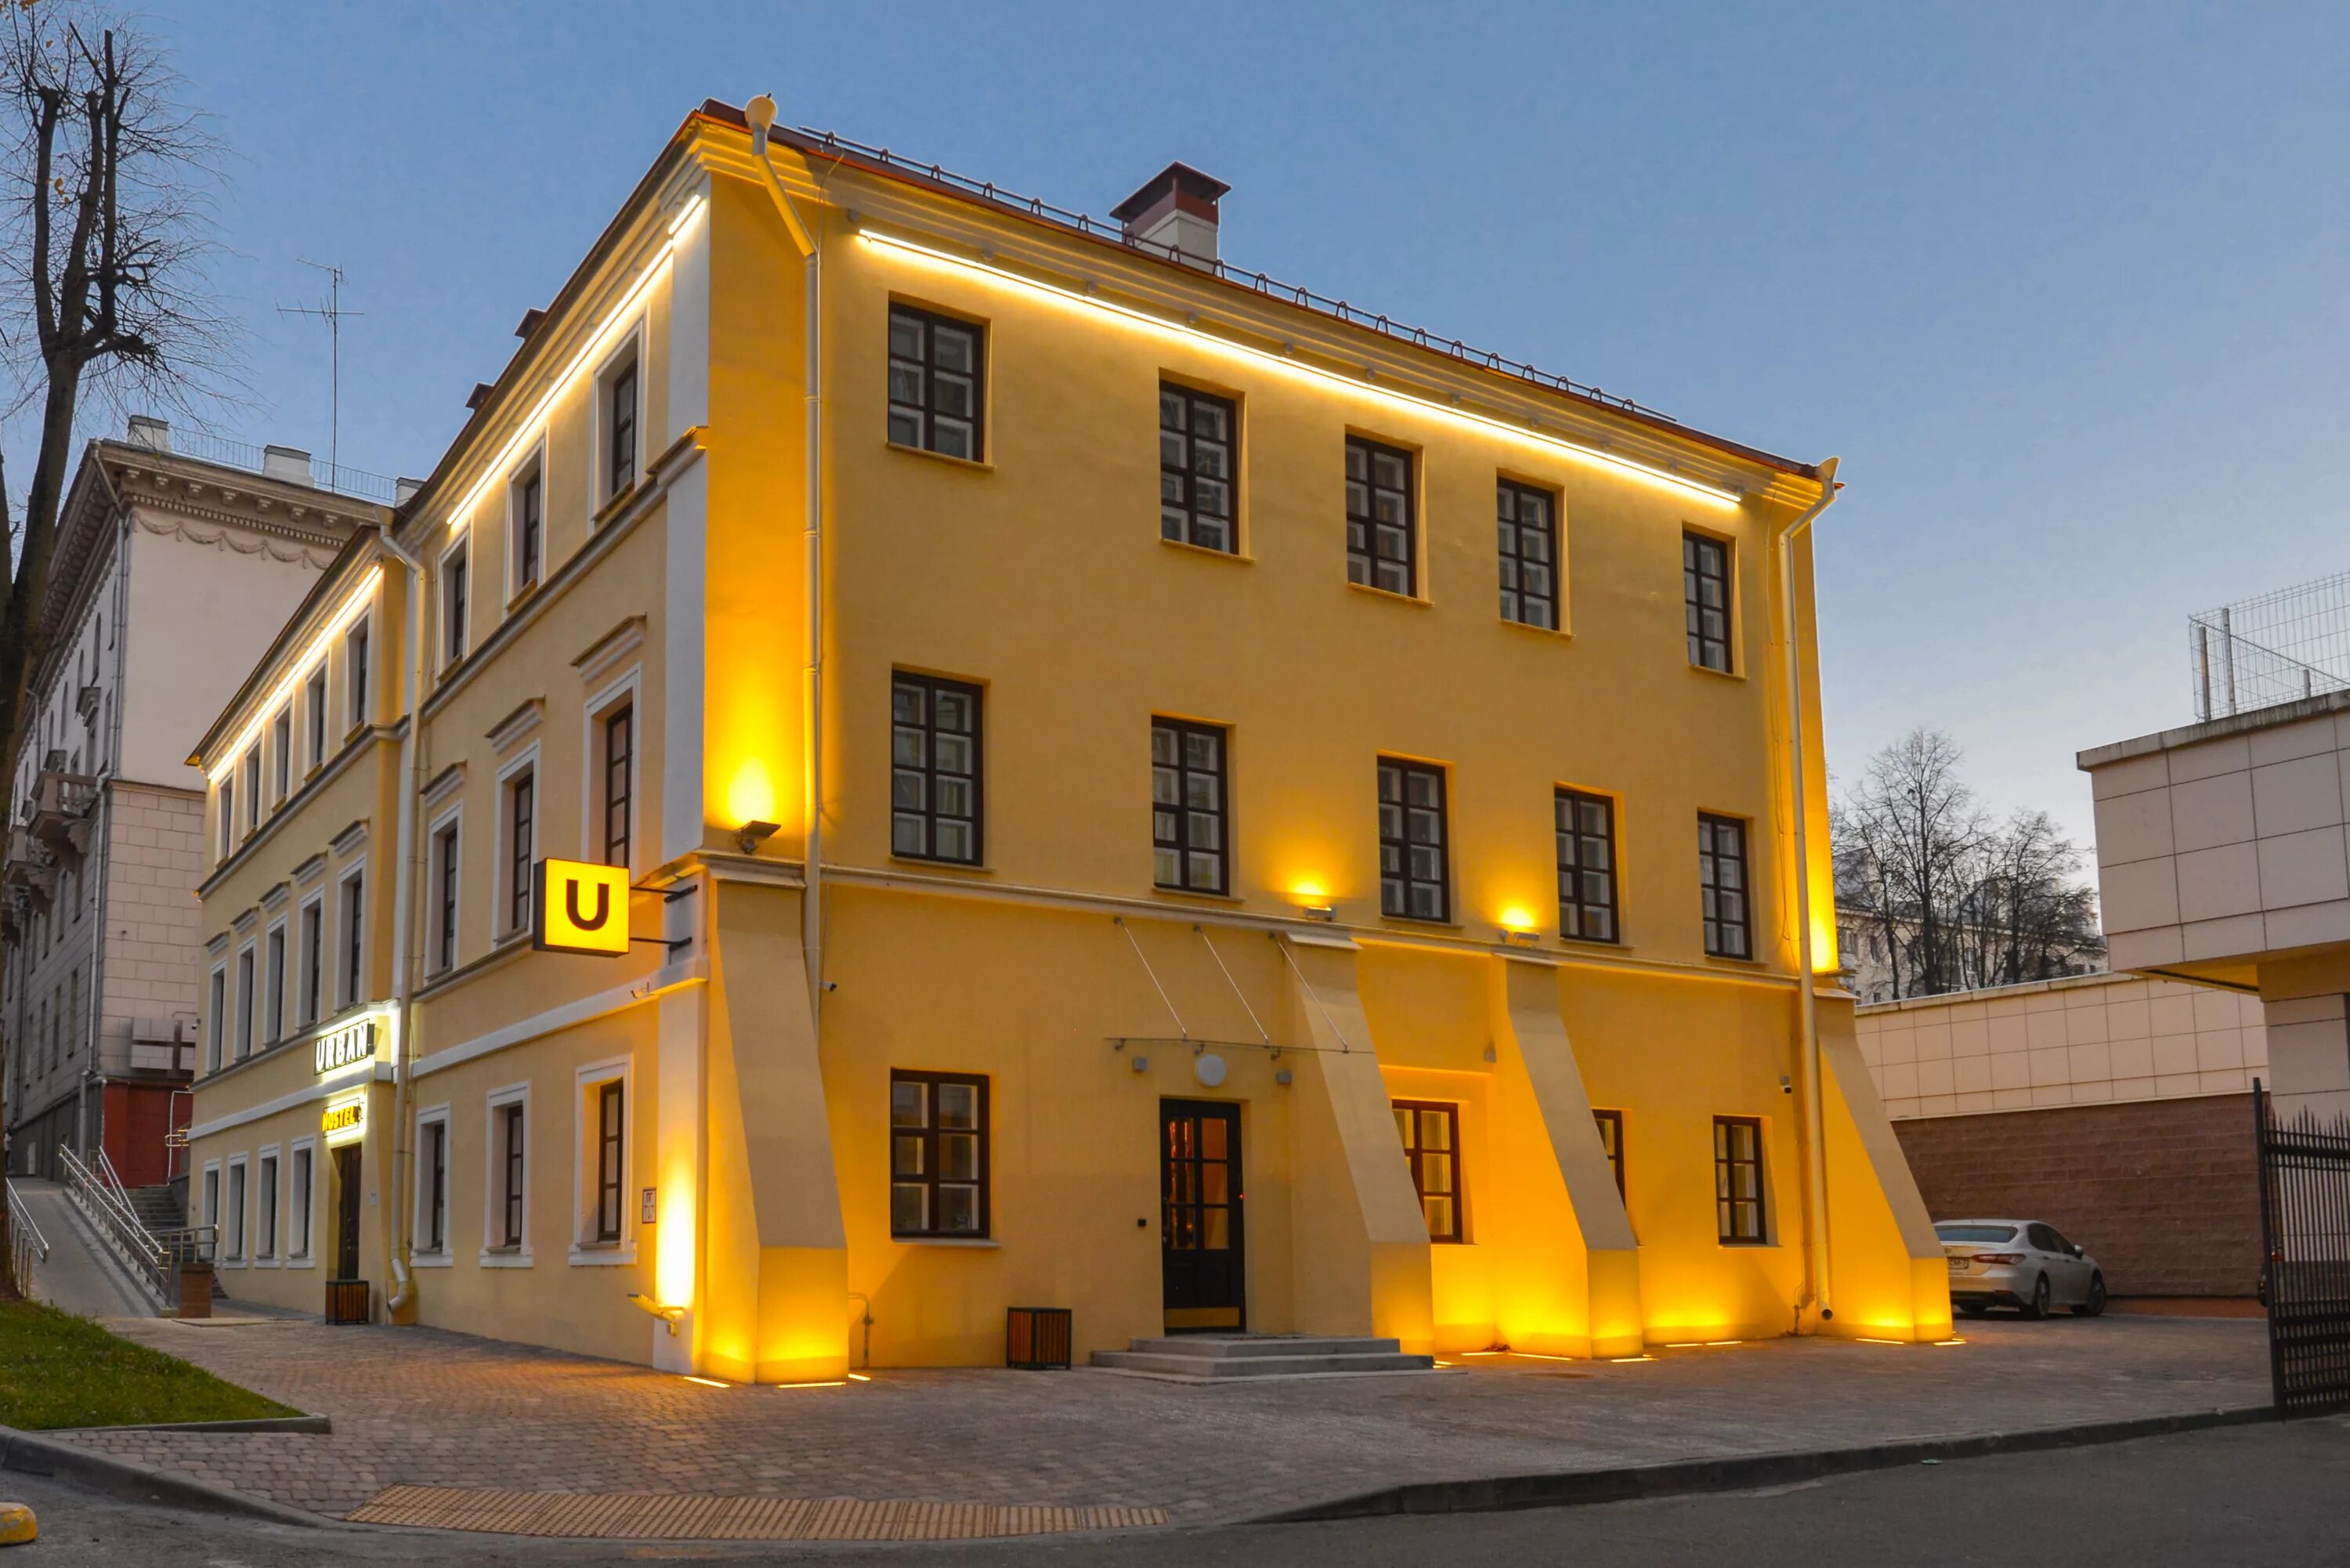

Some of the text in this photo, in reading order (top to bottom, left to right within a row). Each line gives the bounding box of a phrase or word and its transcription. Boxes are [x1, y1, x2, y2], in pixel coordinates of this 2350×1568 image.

[566, 878, 609, 931] U
[315, 1022, 368, 1072] URBAN
[321, 1106, 356, 1132] HOSTEL
